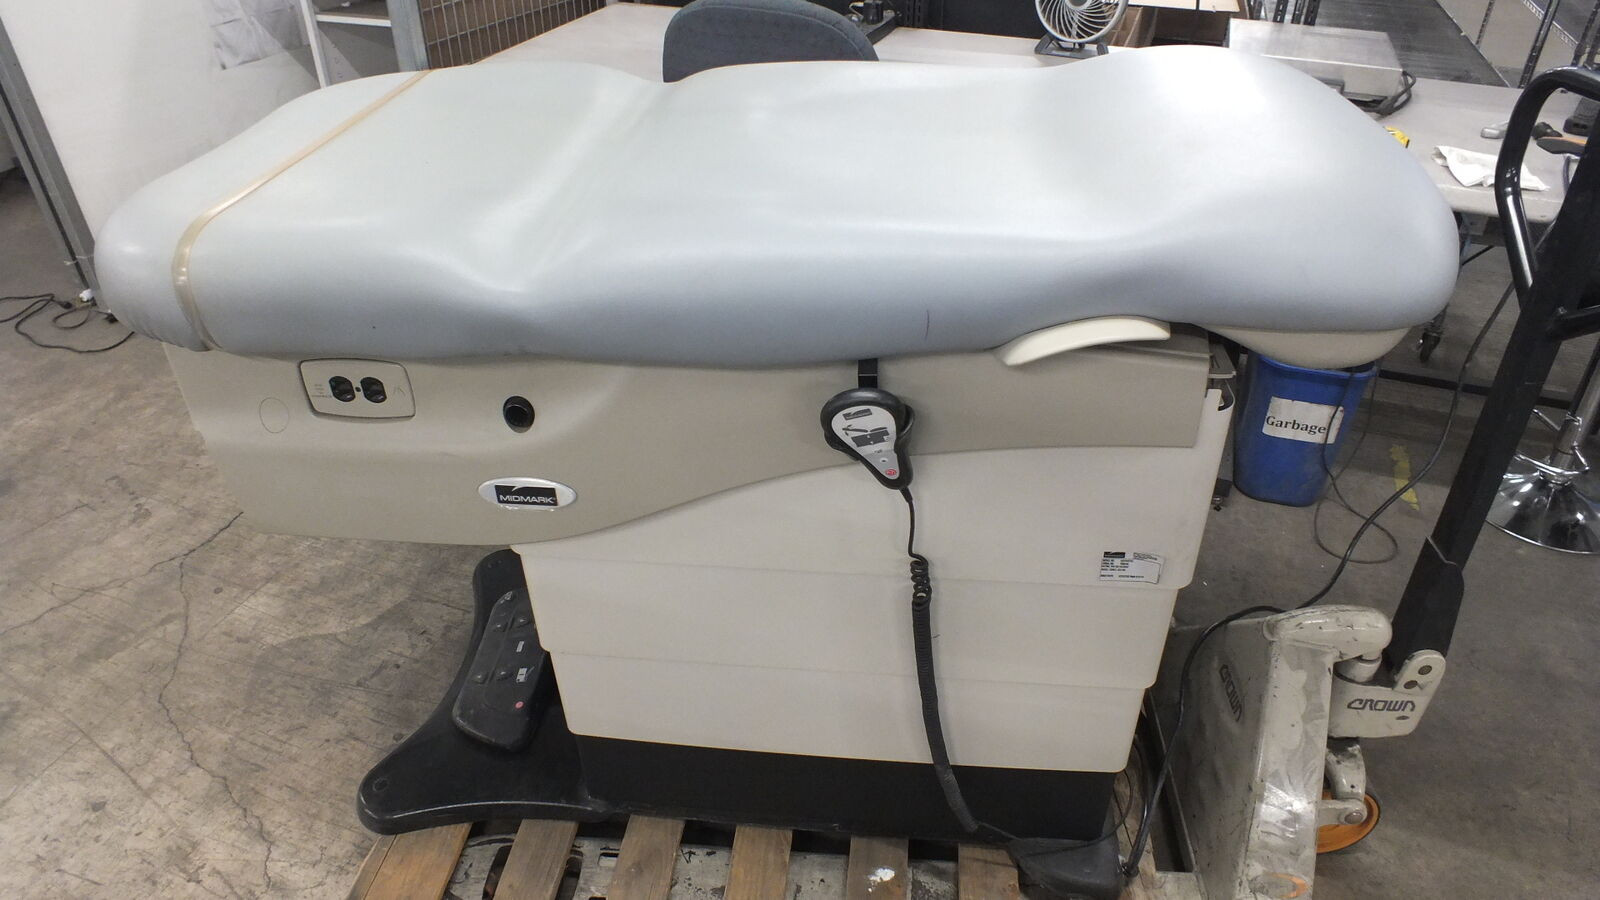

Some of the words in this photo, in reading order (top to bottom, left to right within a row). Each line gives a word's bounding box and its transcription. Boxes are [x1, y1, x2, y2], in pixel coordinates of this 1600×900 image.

[1266, 416, 1327, 435] Garbage
[1219, 664, 1242, 722] CROWN
[1347, 698, 1416, 712] CROWN
